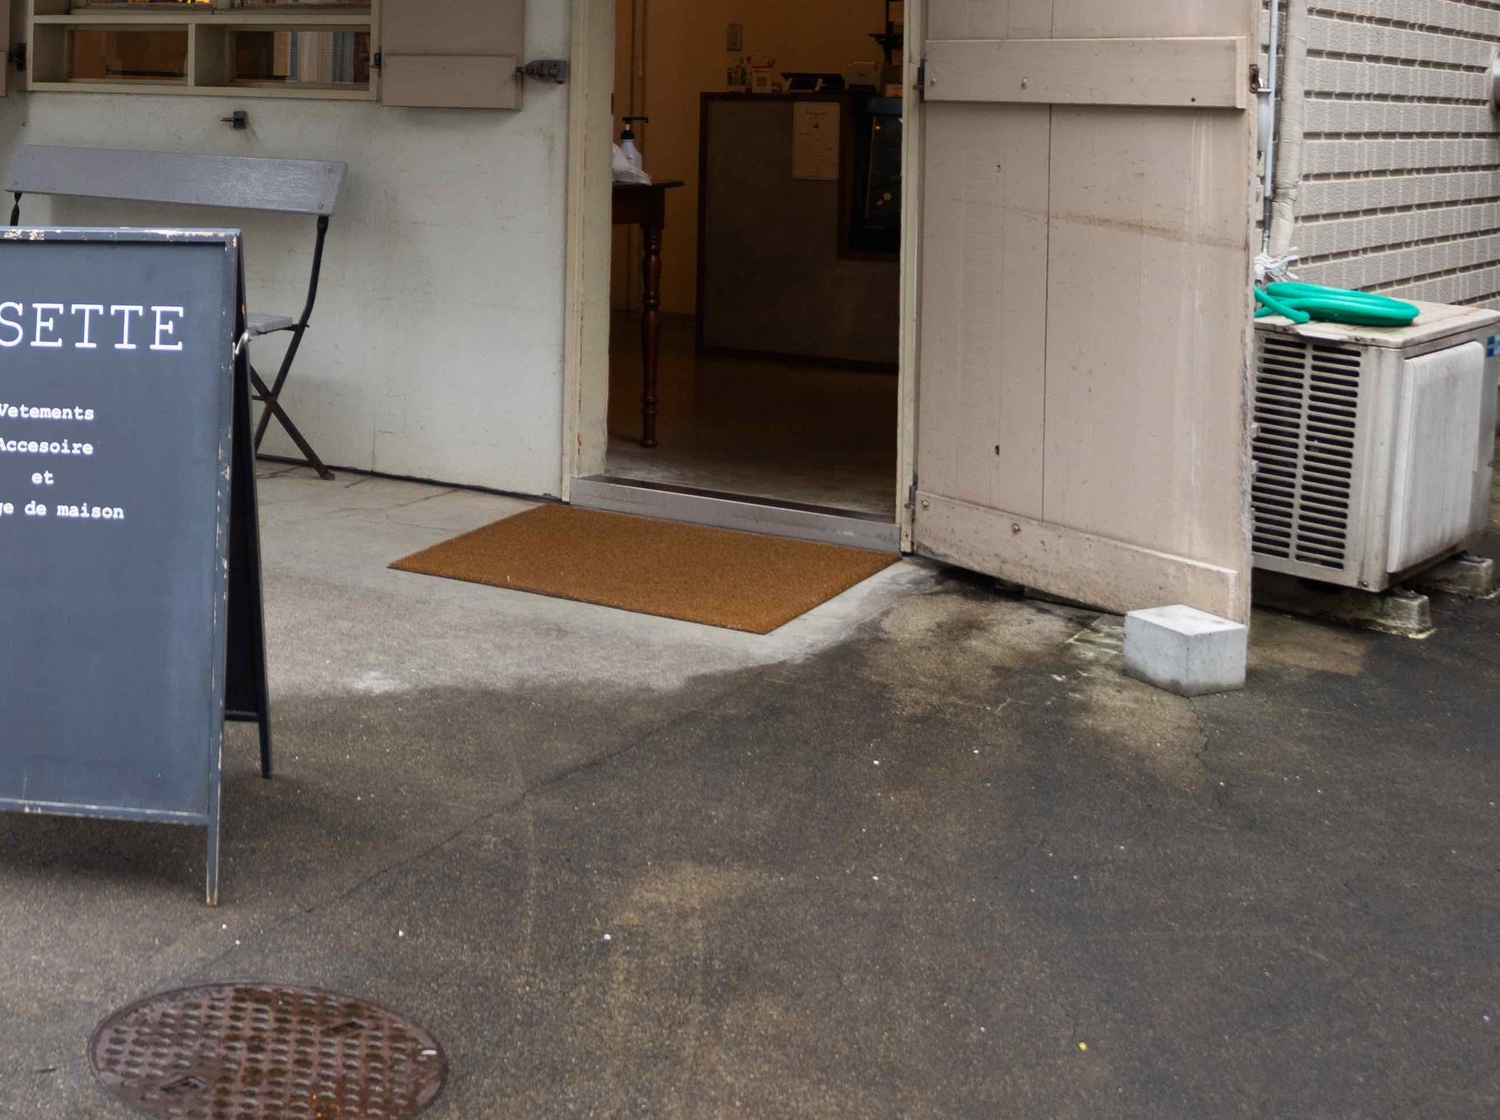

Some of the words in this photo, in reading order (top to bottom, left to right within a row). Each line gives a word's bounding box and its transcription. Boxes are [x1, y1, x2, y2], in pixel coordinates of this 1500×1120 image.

[31, 470, 54, 485] et
[24, 500, 47, 516] de
[56, 503, 125, 519] maison
